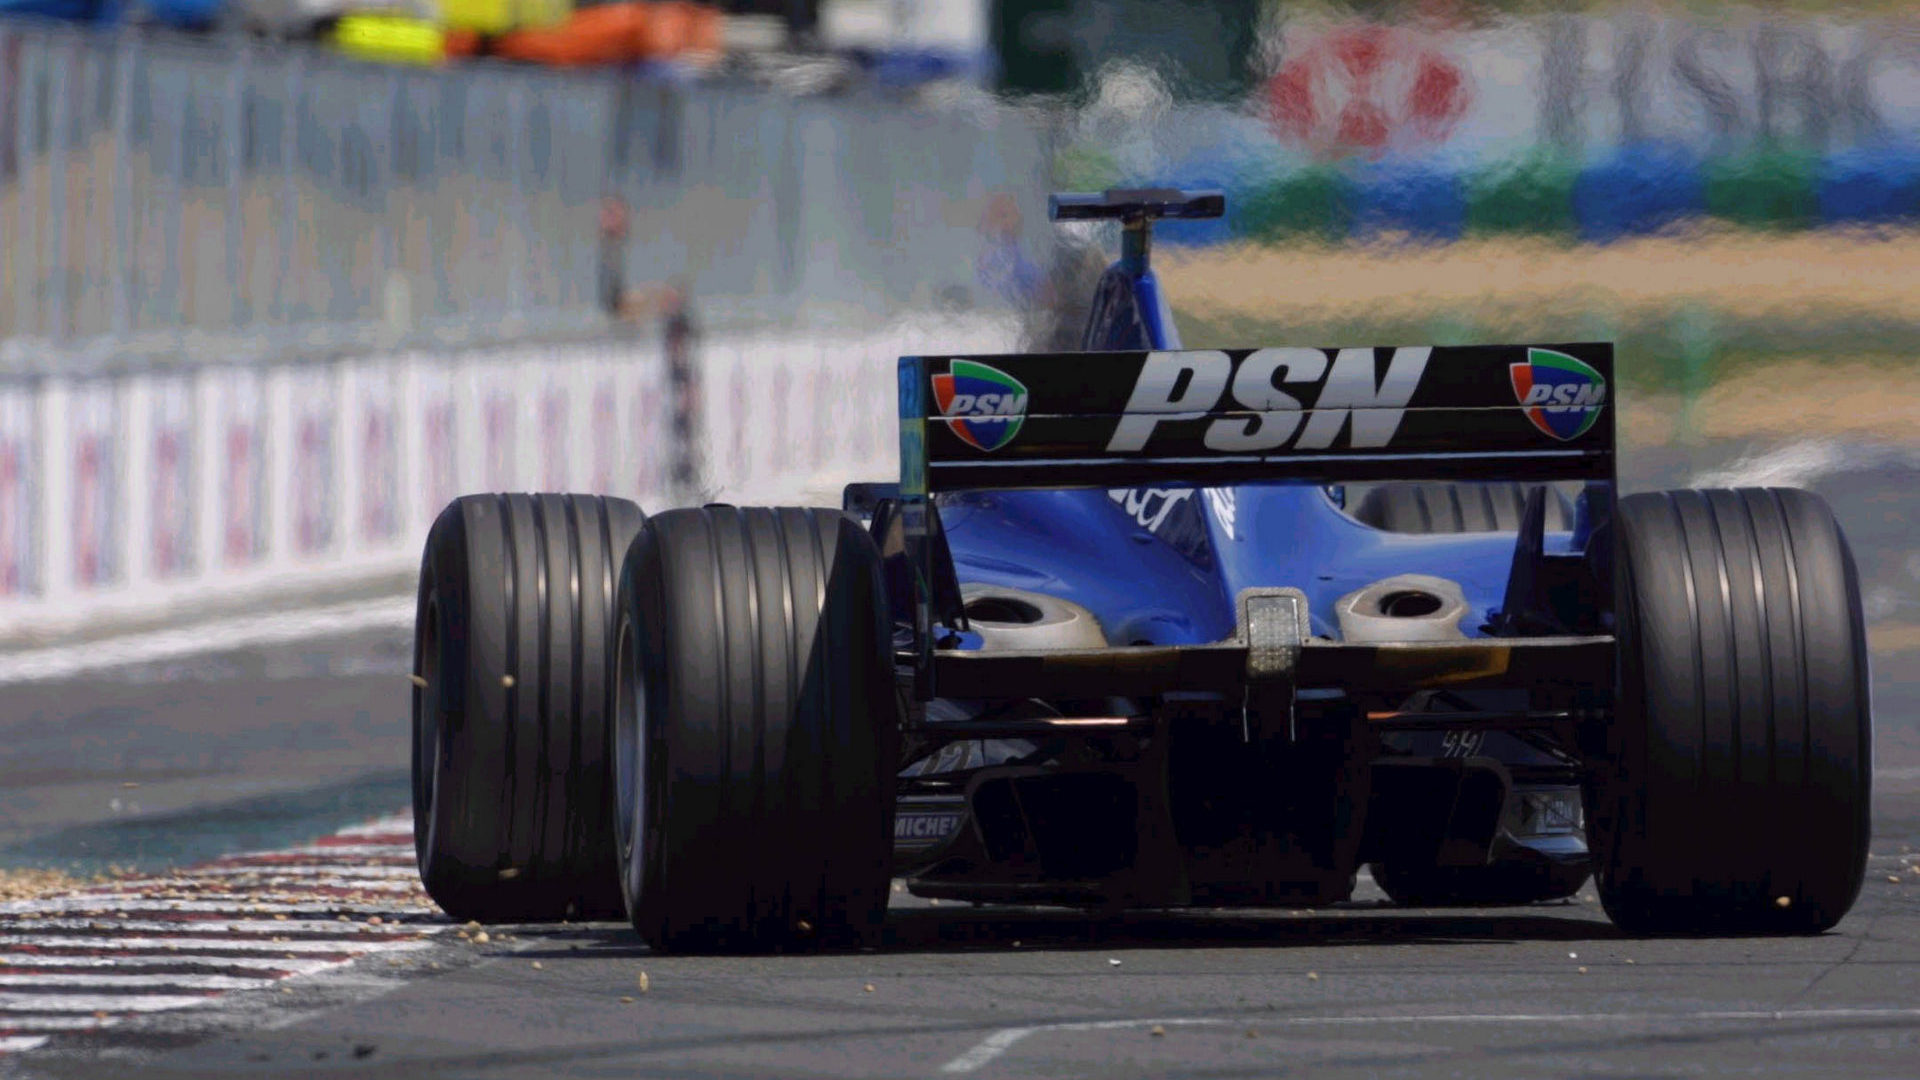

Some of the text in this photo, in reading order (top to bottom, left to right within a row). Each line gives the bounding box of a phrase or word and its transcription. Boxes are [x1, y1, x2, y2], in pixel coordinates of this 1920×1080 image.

[943, 393, 1028, 423] PSN
[1105, 346, 1433, 451] PSN
[1521, 383, 1605, 413] PSN
